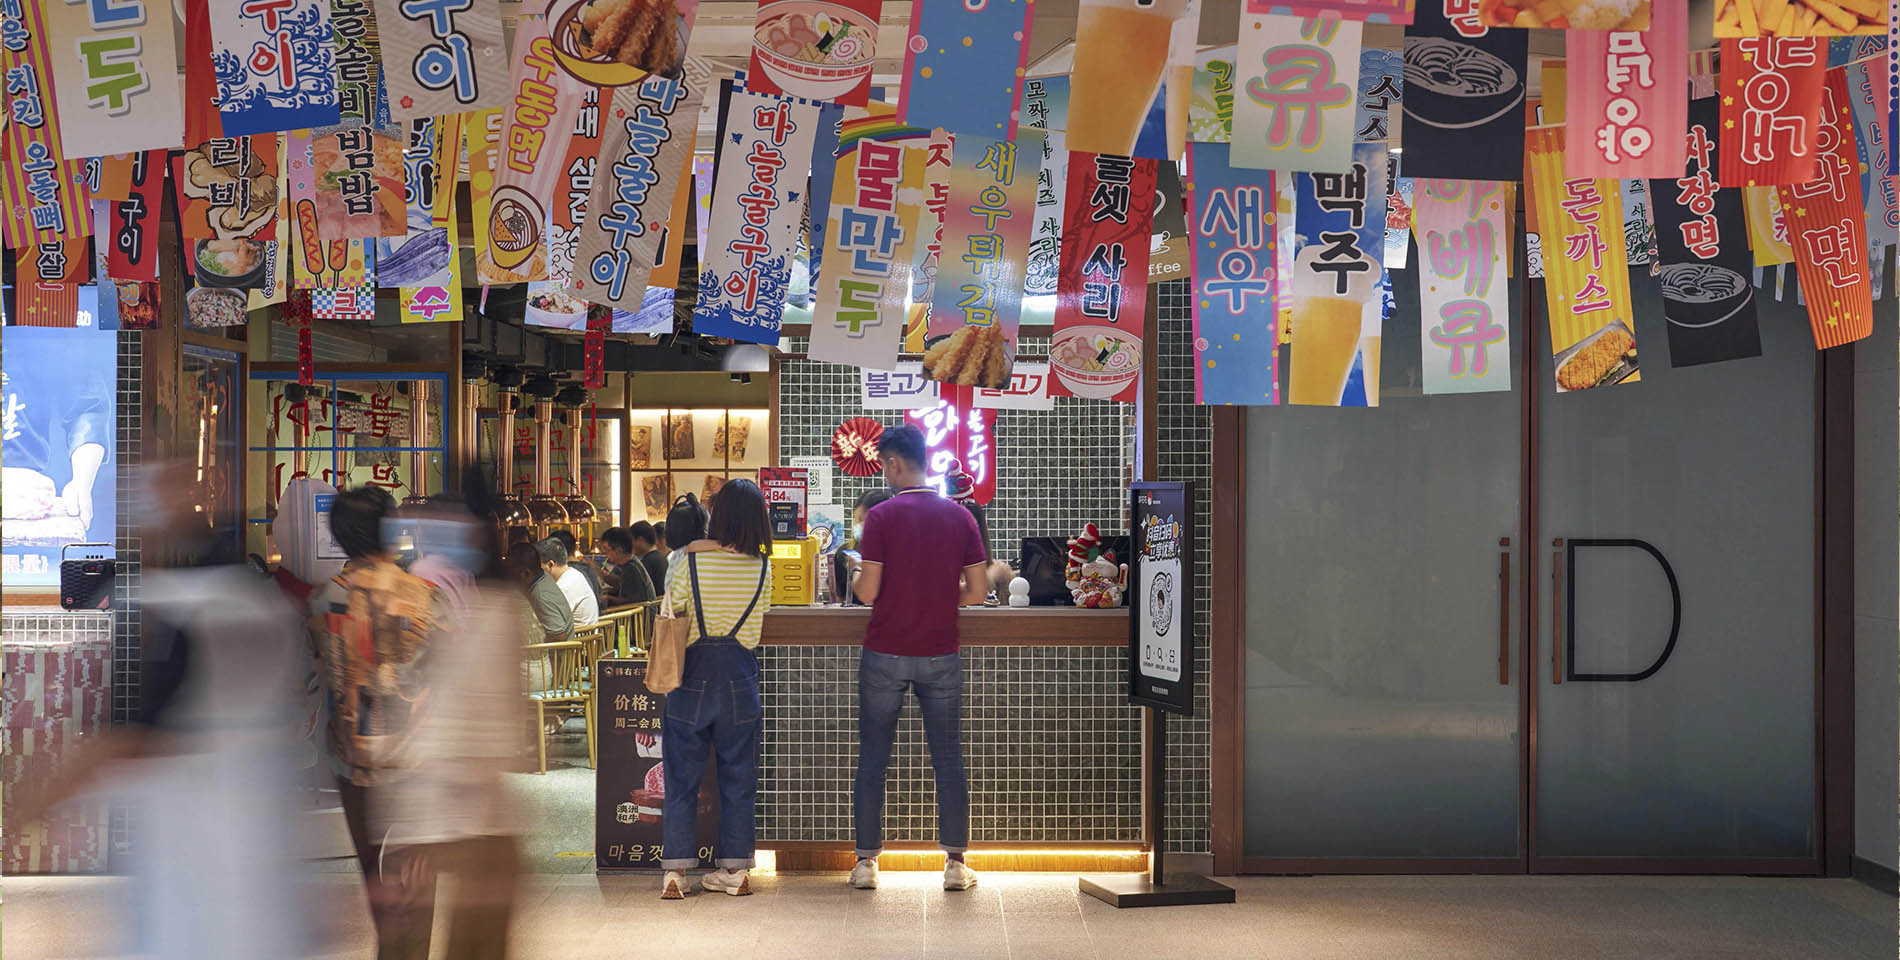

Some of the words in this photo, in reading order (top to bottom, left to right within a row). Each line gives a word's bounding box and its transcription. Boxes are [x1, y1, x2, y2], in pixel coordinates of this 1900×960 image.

[6, 63, 43, 128] 치킨
[507, 36, 558, 174] 우동면
[22, 141, 64, 232] 오돌뼈
[209, 135, 251, 220] 리비
[591, 68, 687, 301] 마늘굴구이
[718, 100, 797, 315] 마늘굴구이
[833, 137, 905, 340] 물만두
[955, 139, 1018, 328] 새우튀김
[1039, 216, 1060, 256] 사리
[1309, 162, 1370, 295] 맥주
[1676, 124, 1721, 260] 자장면
[1082, 241, 1126, 322] 사리
[1148, 262, 1181, 277] ffee
[1200, 186, 1270, 315] 새우
[1560, 178, 1613, 316] 돈까스
[865, 372, 940, 398] 불고기
[1567, 539, 1681, 681] D
[608, 844, 664, 862] 마음껏
